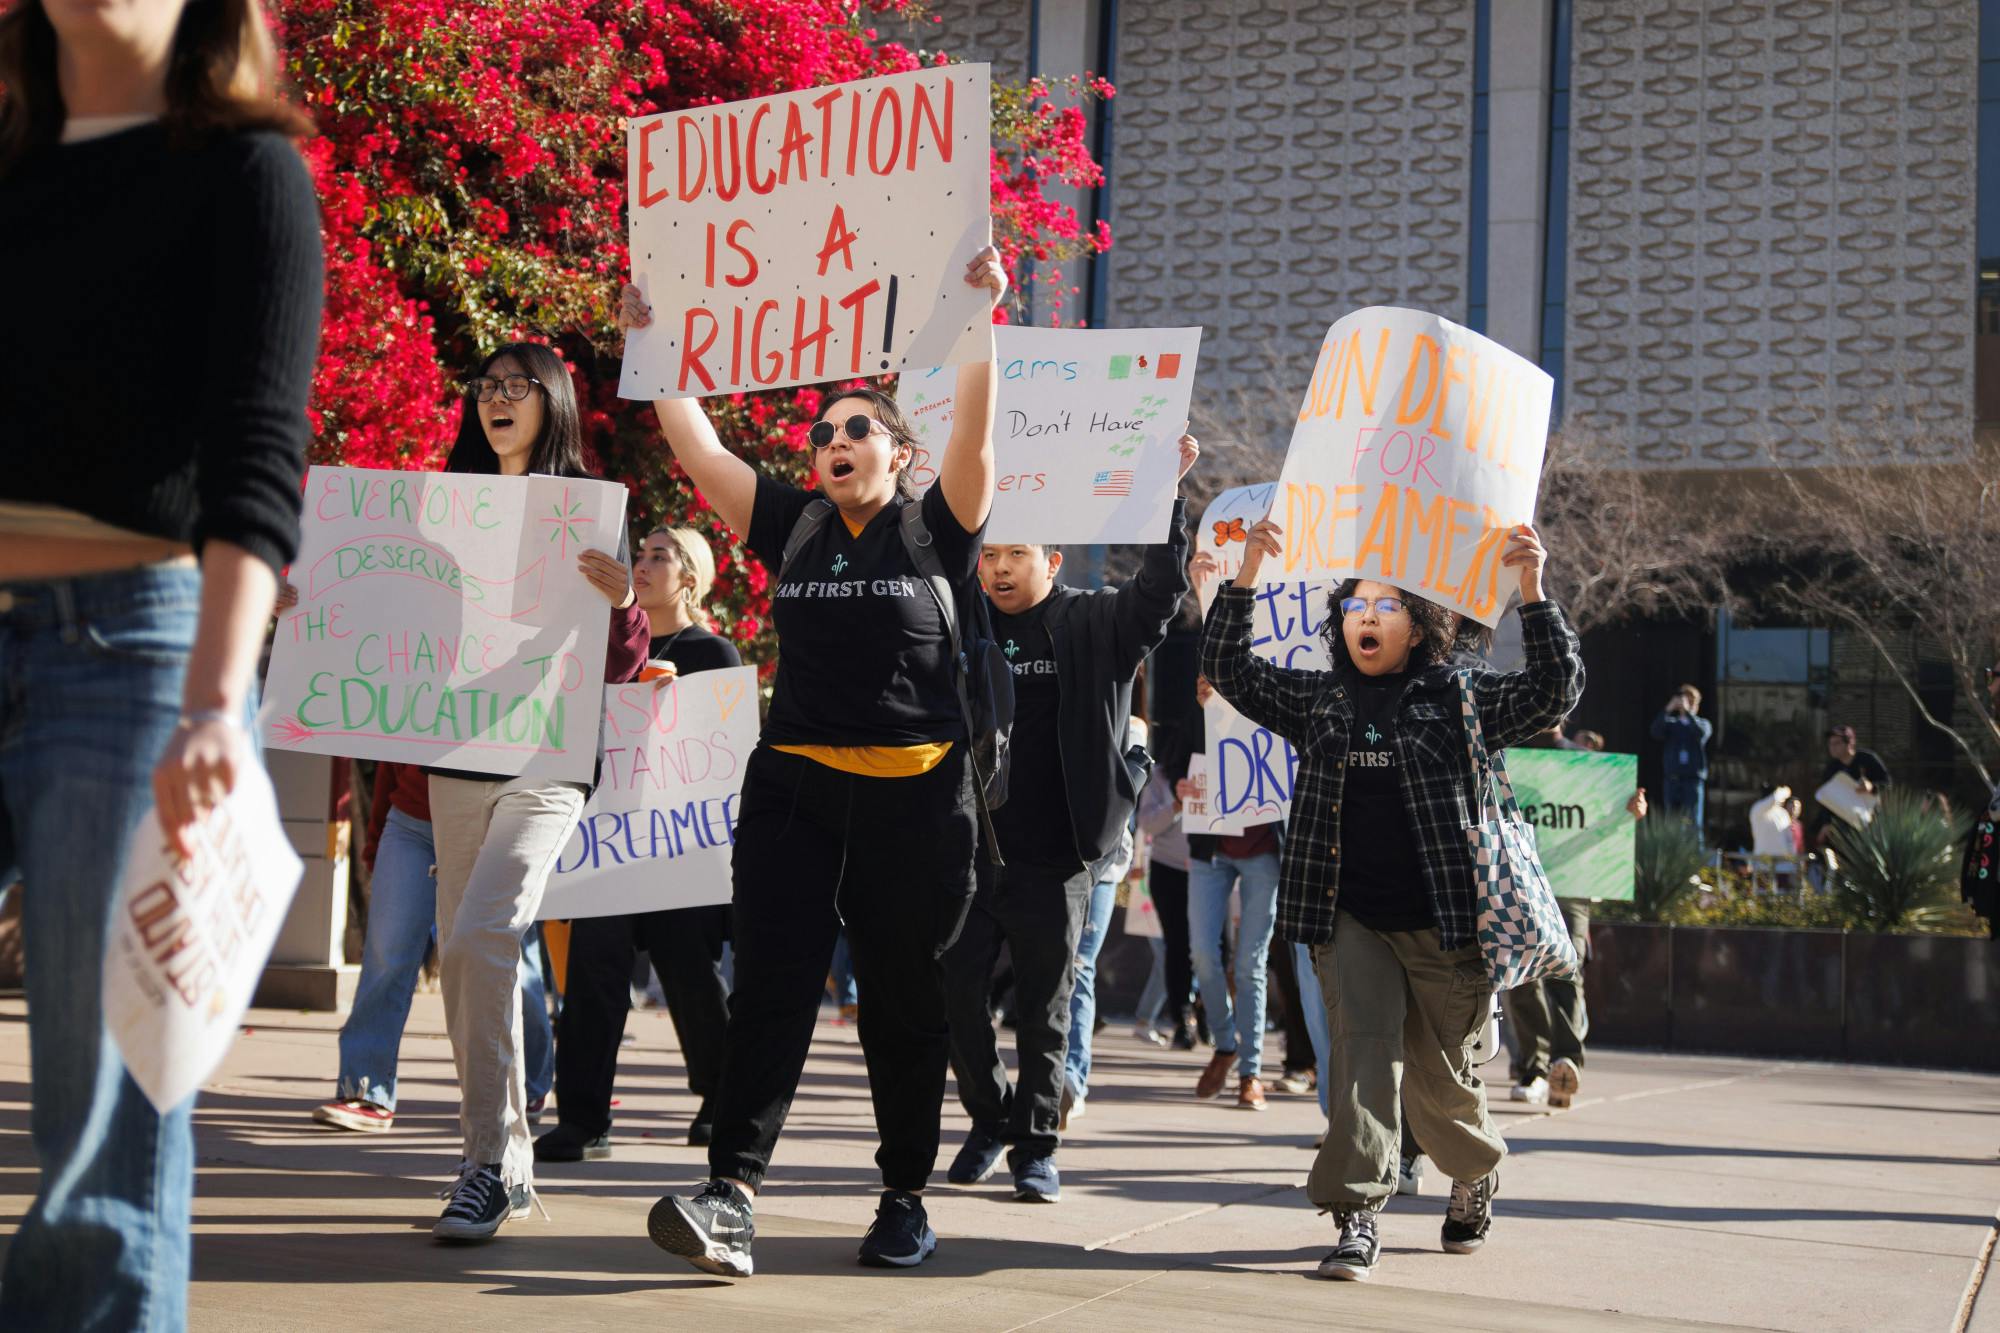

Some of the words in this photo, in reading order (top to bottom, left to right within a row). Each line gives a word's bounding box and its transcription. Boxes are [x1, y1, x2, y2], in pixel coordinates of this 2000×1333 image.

[638, 77, 954, 208] EDUCATION
[705, 219, 759, 288] IS
[816, 203, 858, 276] A
[677, 274, 899, 393] RIGHT!
[1299, 327, 1392, 422] SUN
[1007, 409, 1072, 439] Don't
[1089, 411, 1144, 433] Have
[1350, 427, 1442, 488] FOR
[316, 474, 501, 530] EVERYONE
[335, 544, 485, 601] DESERVES
[805, 580, 866, 599] FIRST
[872, 579, 916, 598] GEN
[288, 604, 352, 642] THE
[355, 631, 498, 676] CHANCE
[522, 652, 584, 692] TO
[297, 672, 565, 750] EDUCATION
[600, 731, 737, 790] TANDS
